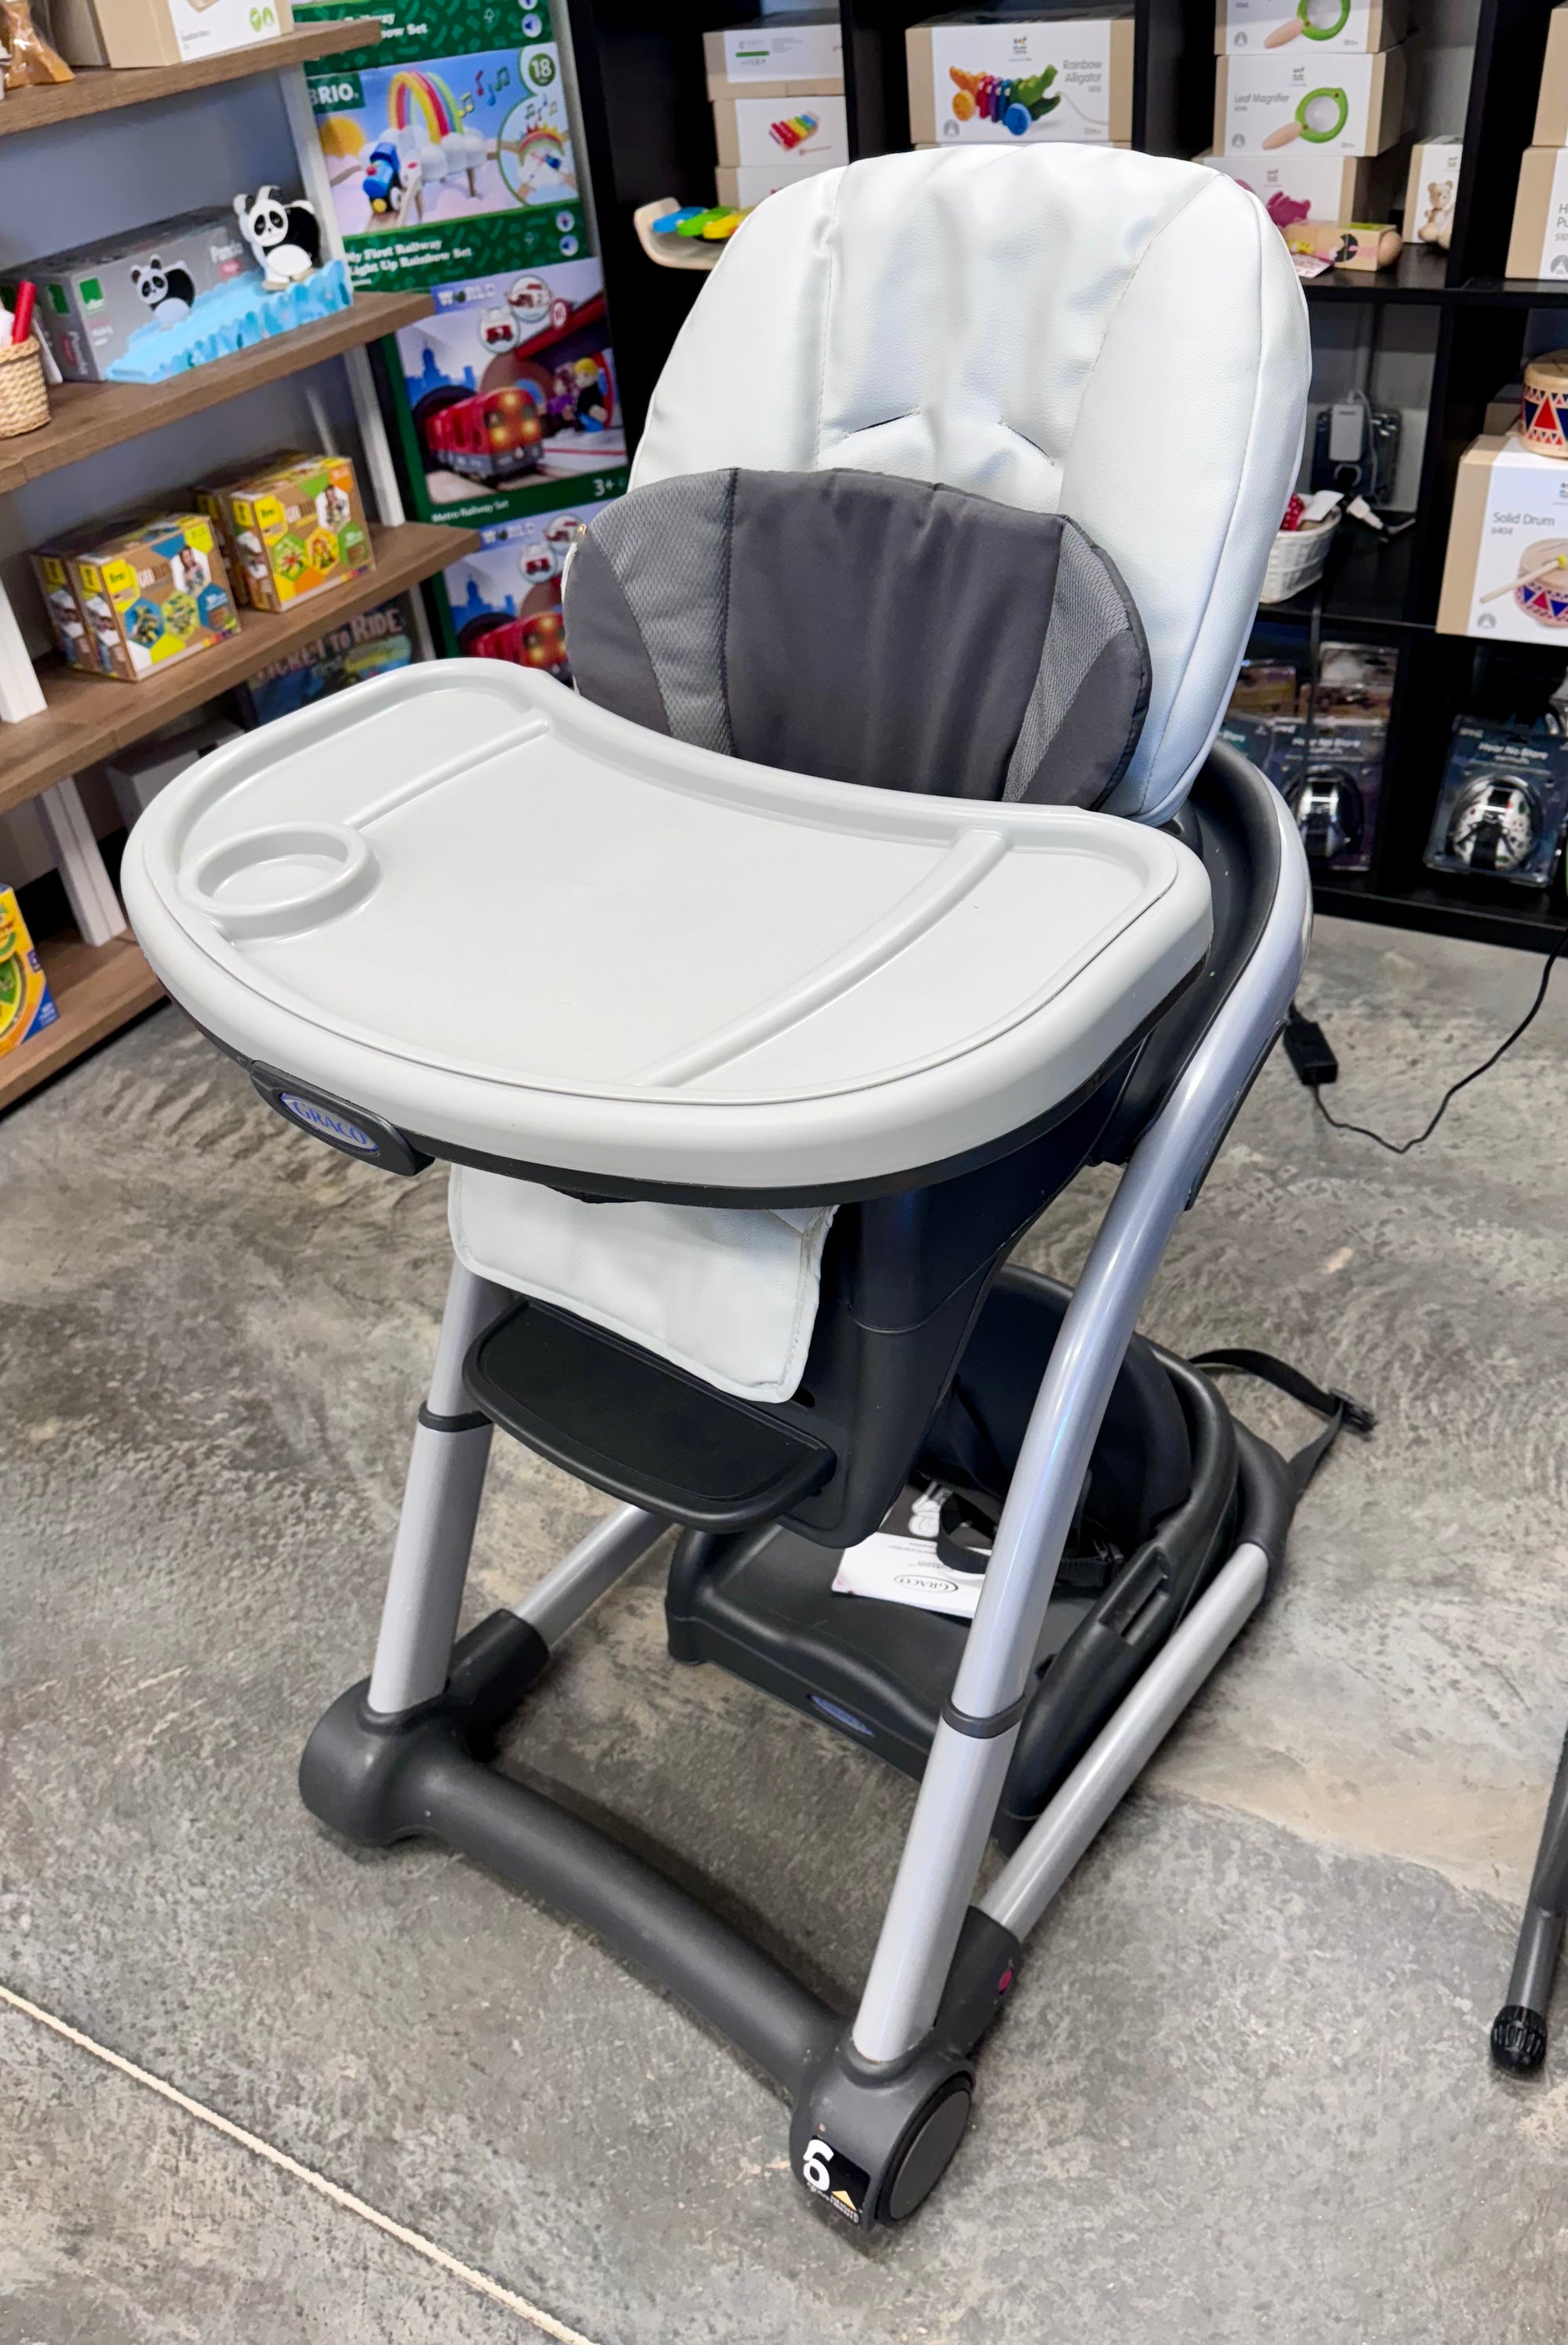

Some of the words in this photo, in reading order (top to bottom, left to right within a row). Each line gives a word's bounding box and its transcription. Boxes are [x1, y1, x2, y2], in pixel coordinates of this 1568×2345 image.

[532, 59, 552, 78] 18
[1063, 60, 1102, 70] Rainbow
[1065, 73, 1102, 85] Alligator
[309, 82, 354, 105] BRIO
[1234, 93, 1251, 103] Leaf
[1252, 93, 1290, 105] Magnifier
[364, 246, 394, 260] First
[394, 240, 443, 255] Railway
[350, 262, 379, 277] Light
[379, 260, 398, 272] Up
[399, 251, 451, 267] Rainbow
[452, 247, 472, 259] Set
[593, 477, 615, 497] 3+
[432, 510, 458, 524] Metro
[459, 504, 493, 518] Railway
[495, 499, 510, 510] Set
[1493, 512, 1521, 525] Solid
[1523, 514, 1555, 526] Drum
[352, 608, 403, 643] RIDE
[292, 1101, 367, 1145] GRACO
[900, 1577, 949, 1592] GRACO
[803, 2139, 834, 2191] 6
